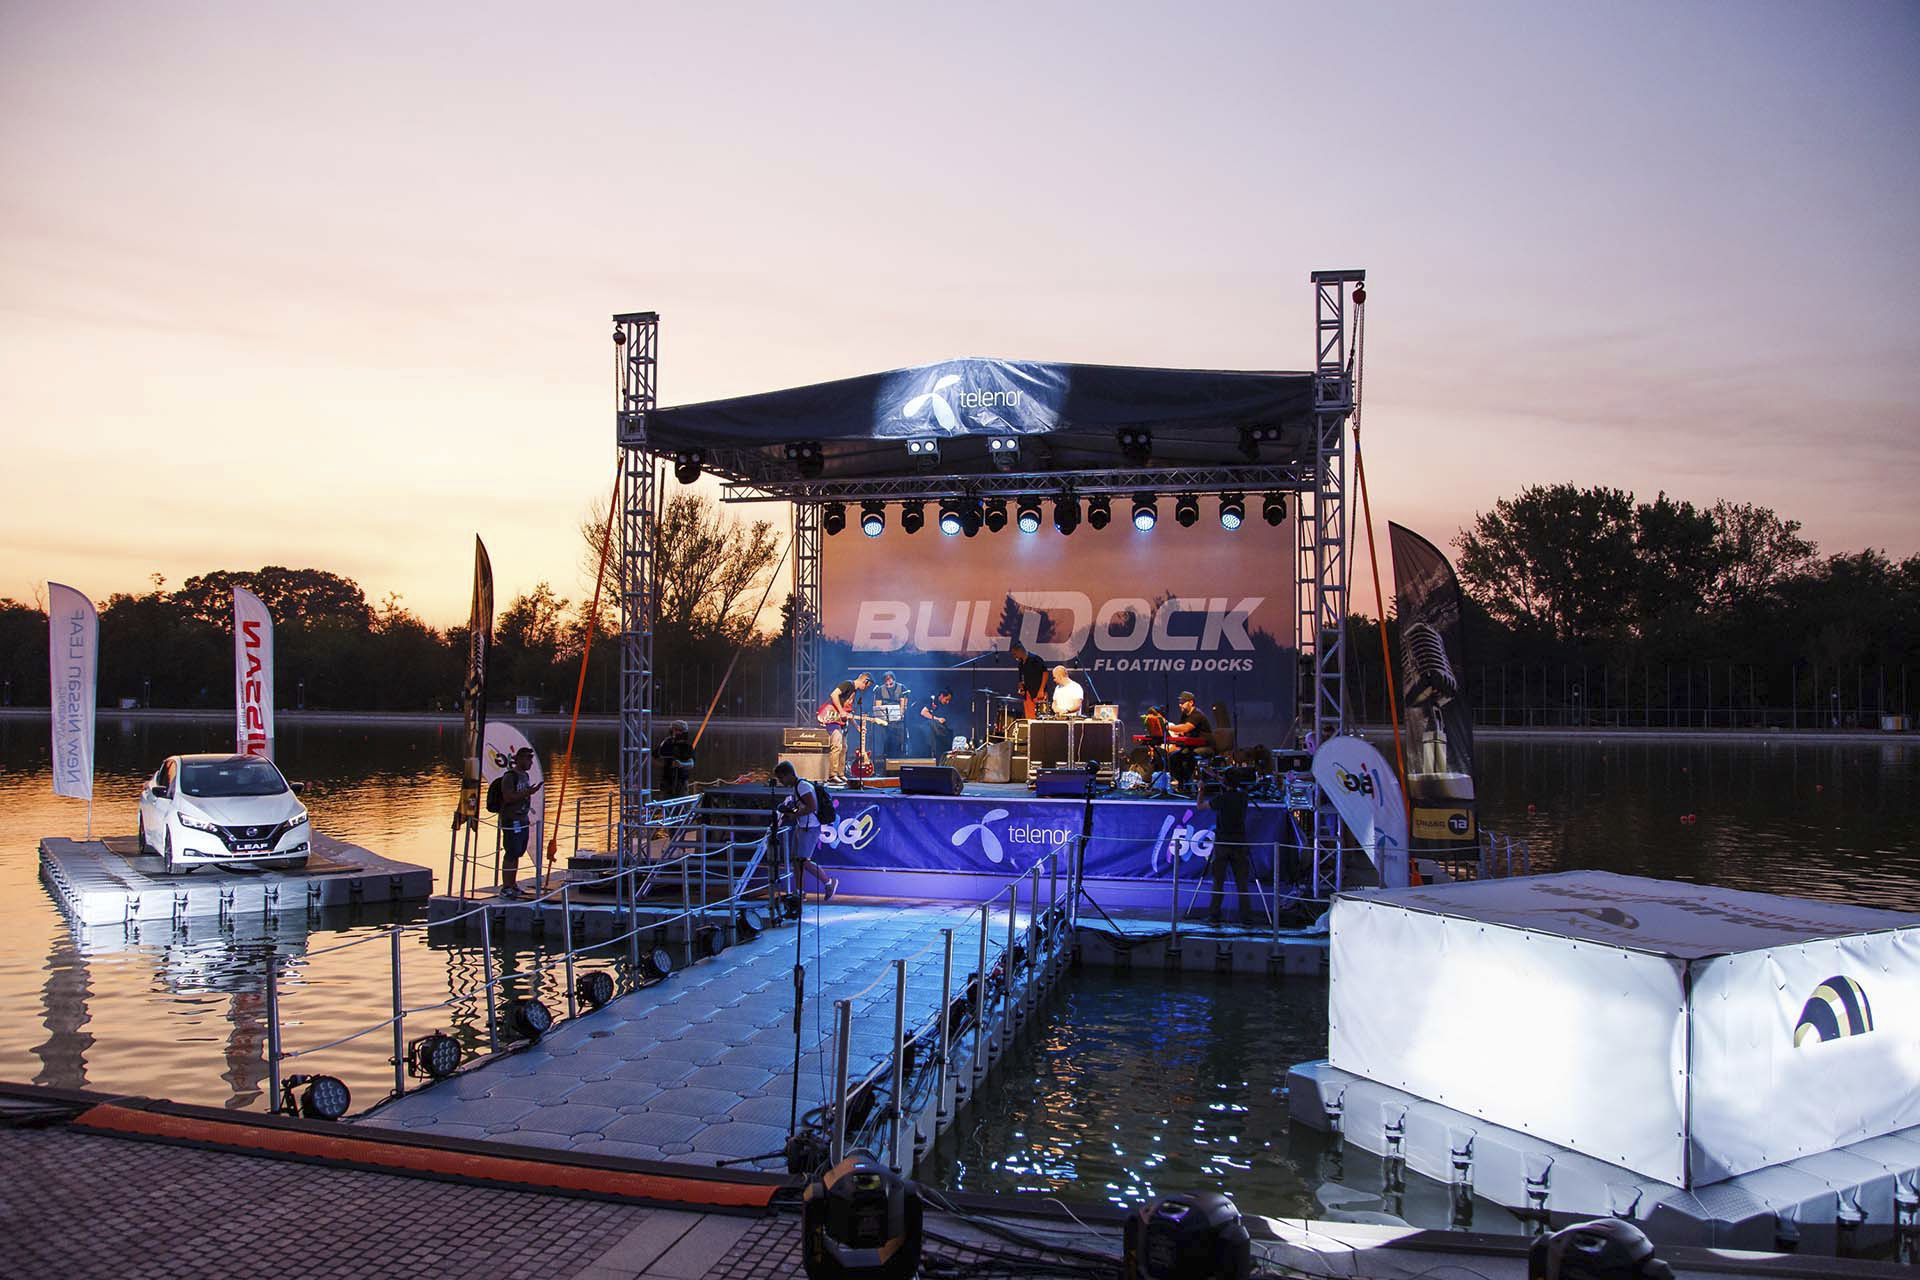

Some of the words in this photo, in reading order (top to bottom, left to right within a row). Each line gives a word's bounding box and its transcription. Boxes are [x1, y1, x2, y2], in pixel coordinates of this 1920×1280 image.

[960, 389, 1024, 408] telenor
[852, 591, 1265, 661] BULDOCK
[1094, 658, 1186, 671] FLOATING
[1190, 658, 1254, 671] DOCKS
[820, 818, 862, 844] 5G
[1008, 823, 1072, 845] telenor
[1168, 828, 1216, 857] 5G
